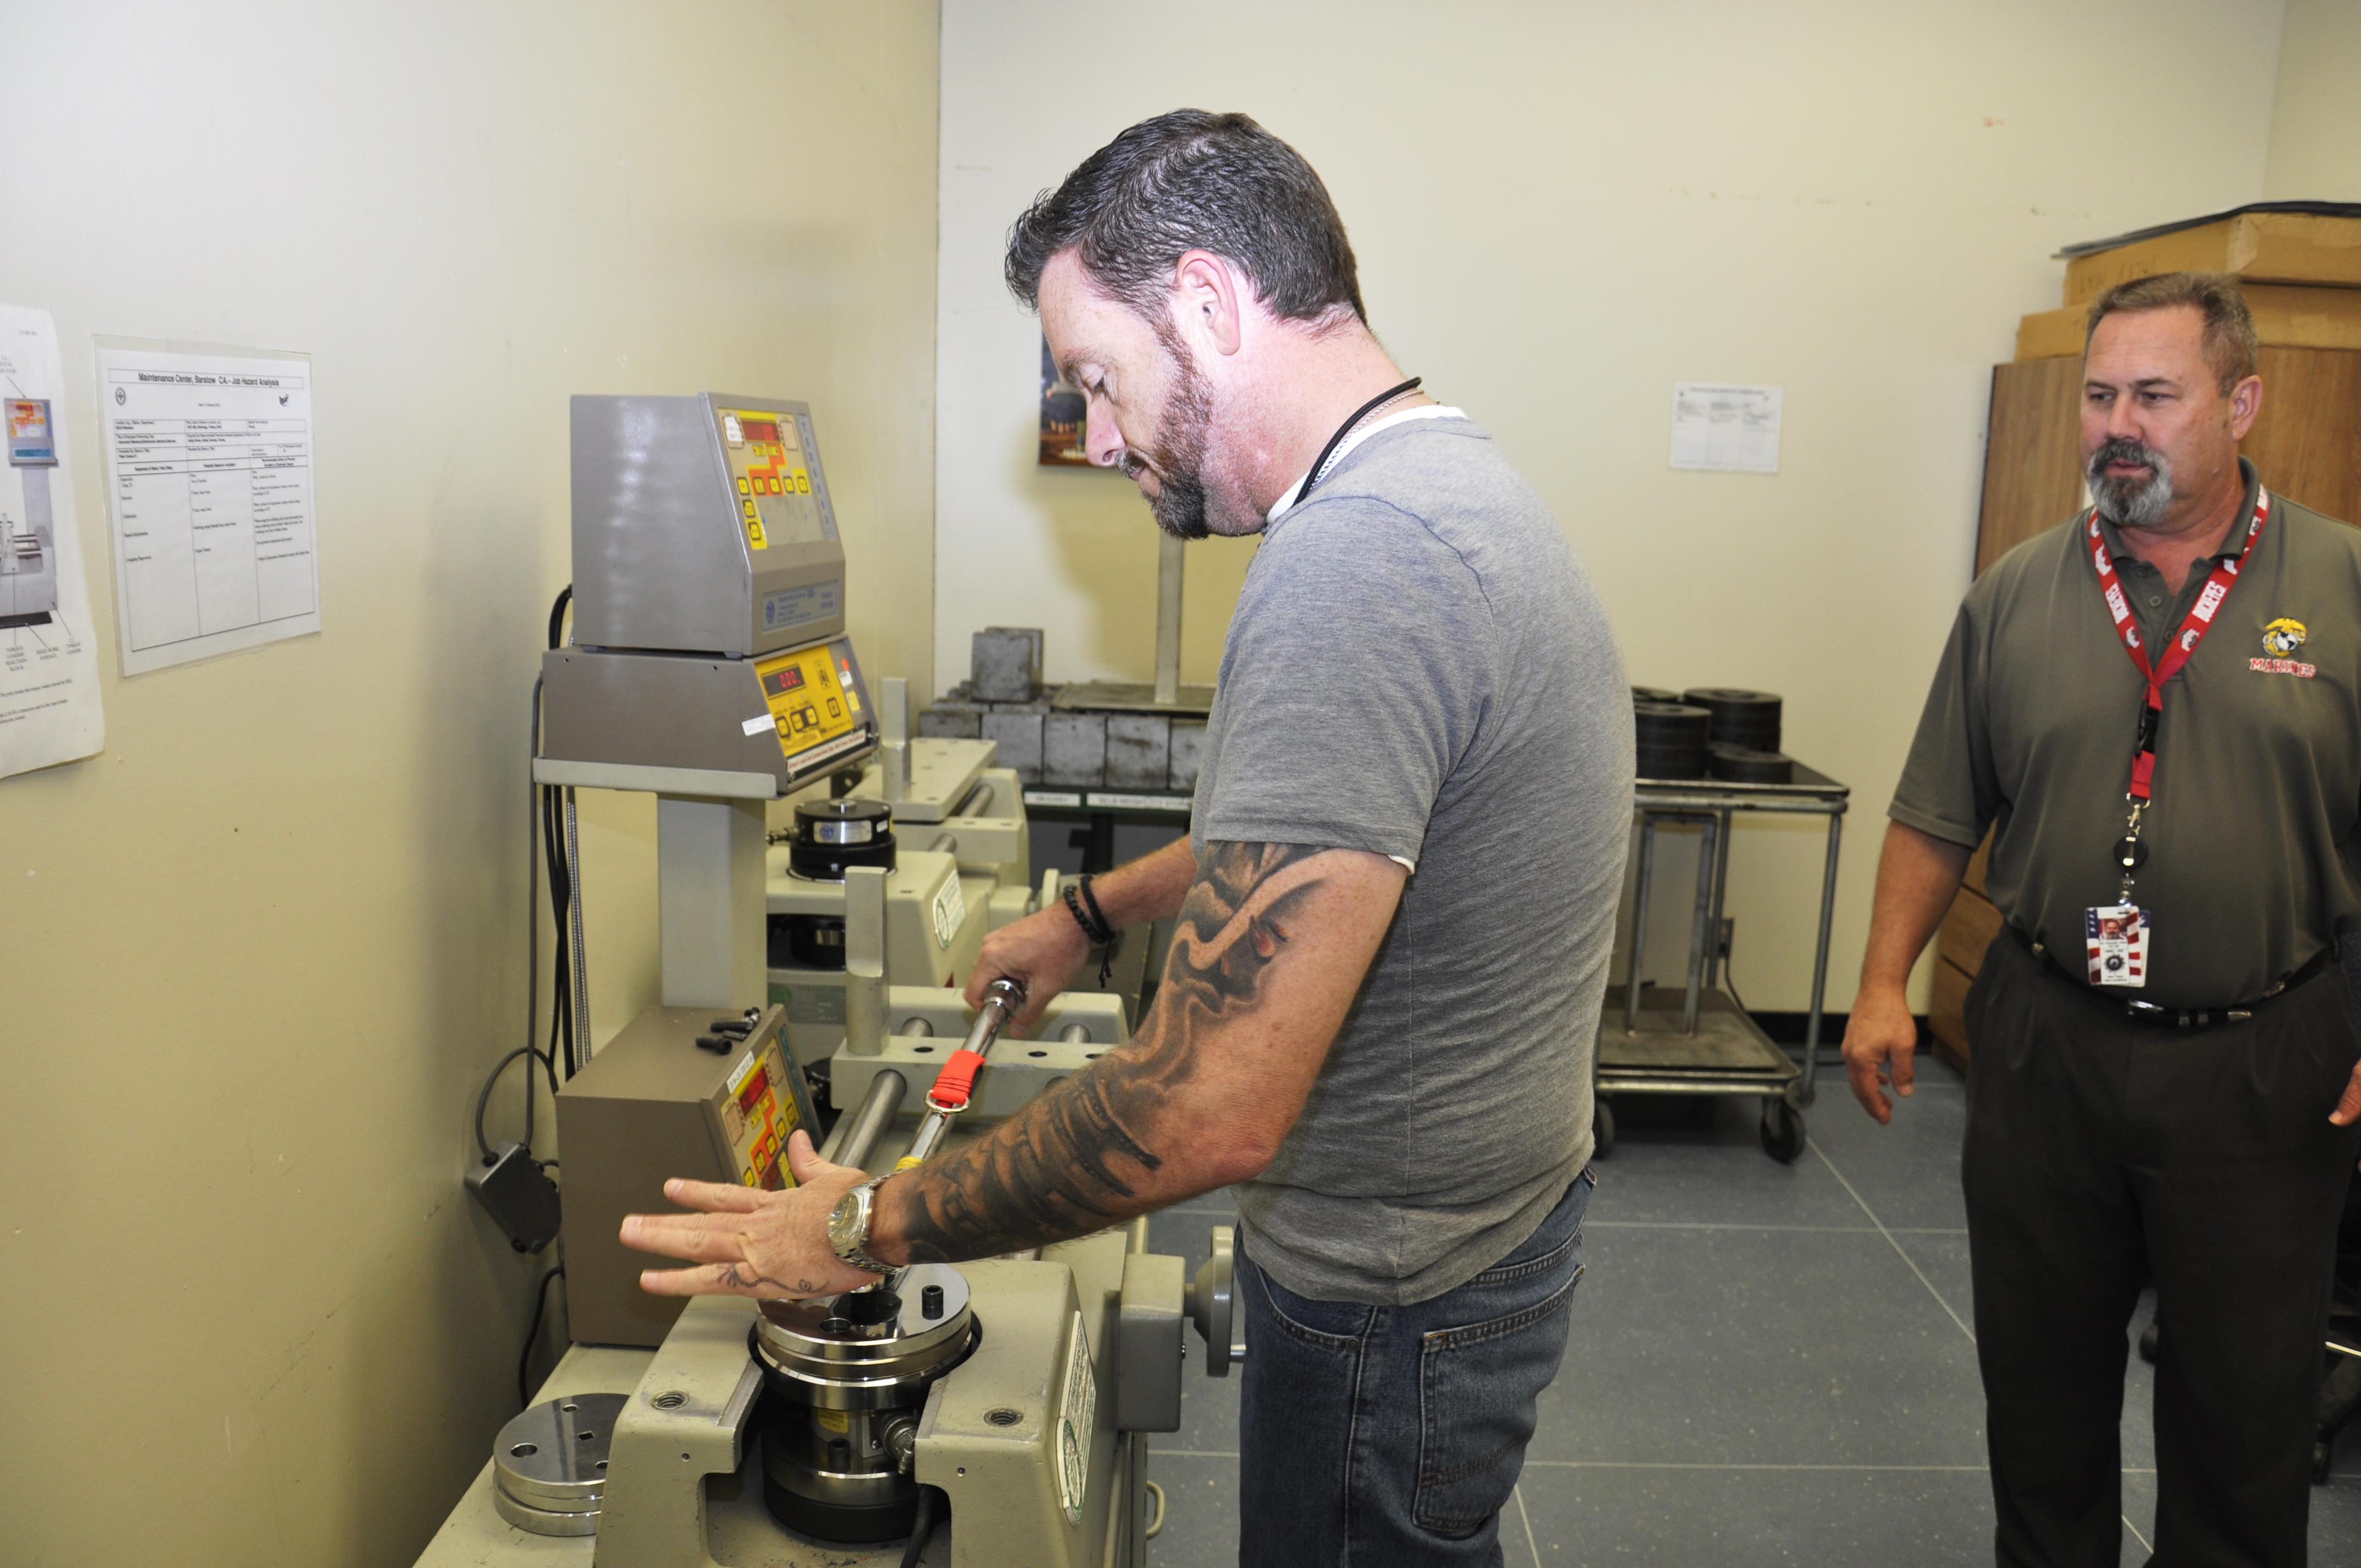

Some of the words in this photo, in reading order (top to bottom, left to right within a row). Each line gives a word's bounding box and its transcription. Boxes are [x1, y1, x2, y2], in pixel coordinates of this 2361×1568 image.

[138, 373, 174, 382] Maintenance
[175, 374, 194, 384] Center,
[195, 375, 215, 384] Barstow
[259, 378, 279, 388] Analysis
[2249, 657, 2316, 678] MARINES
